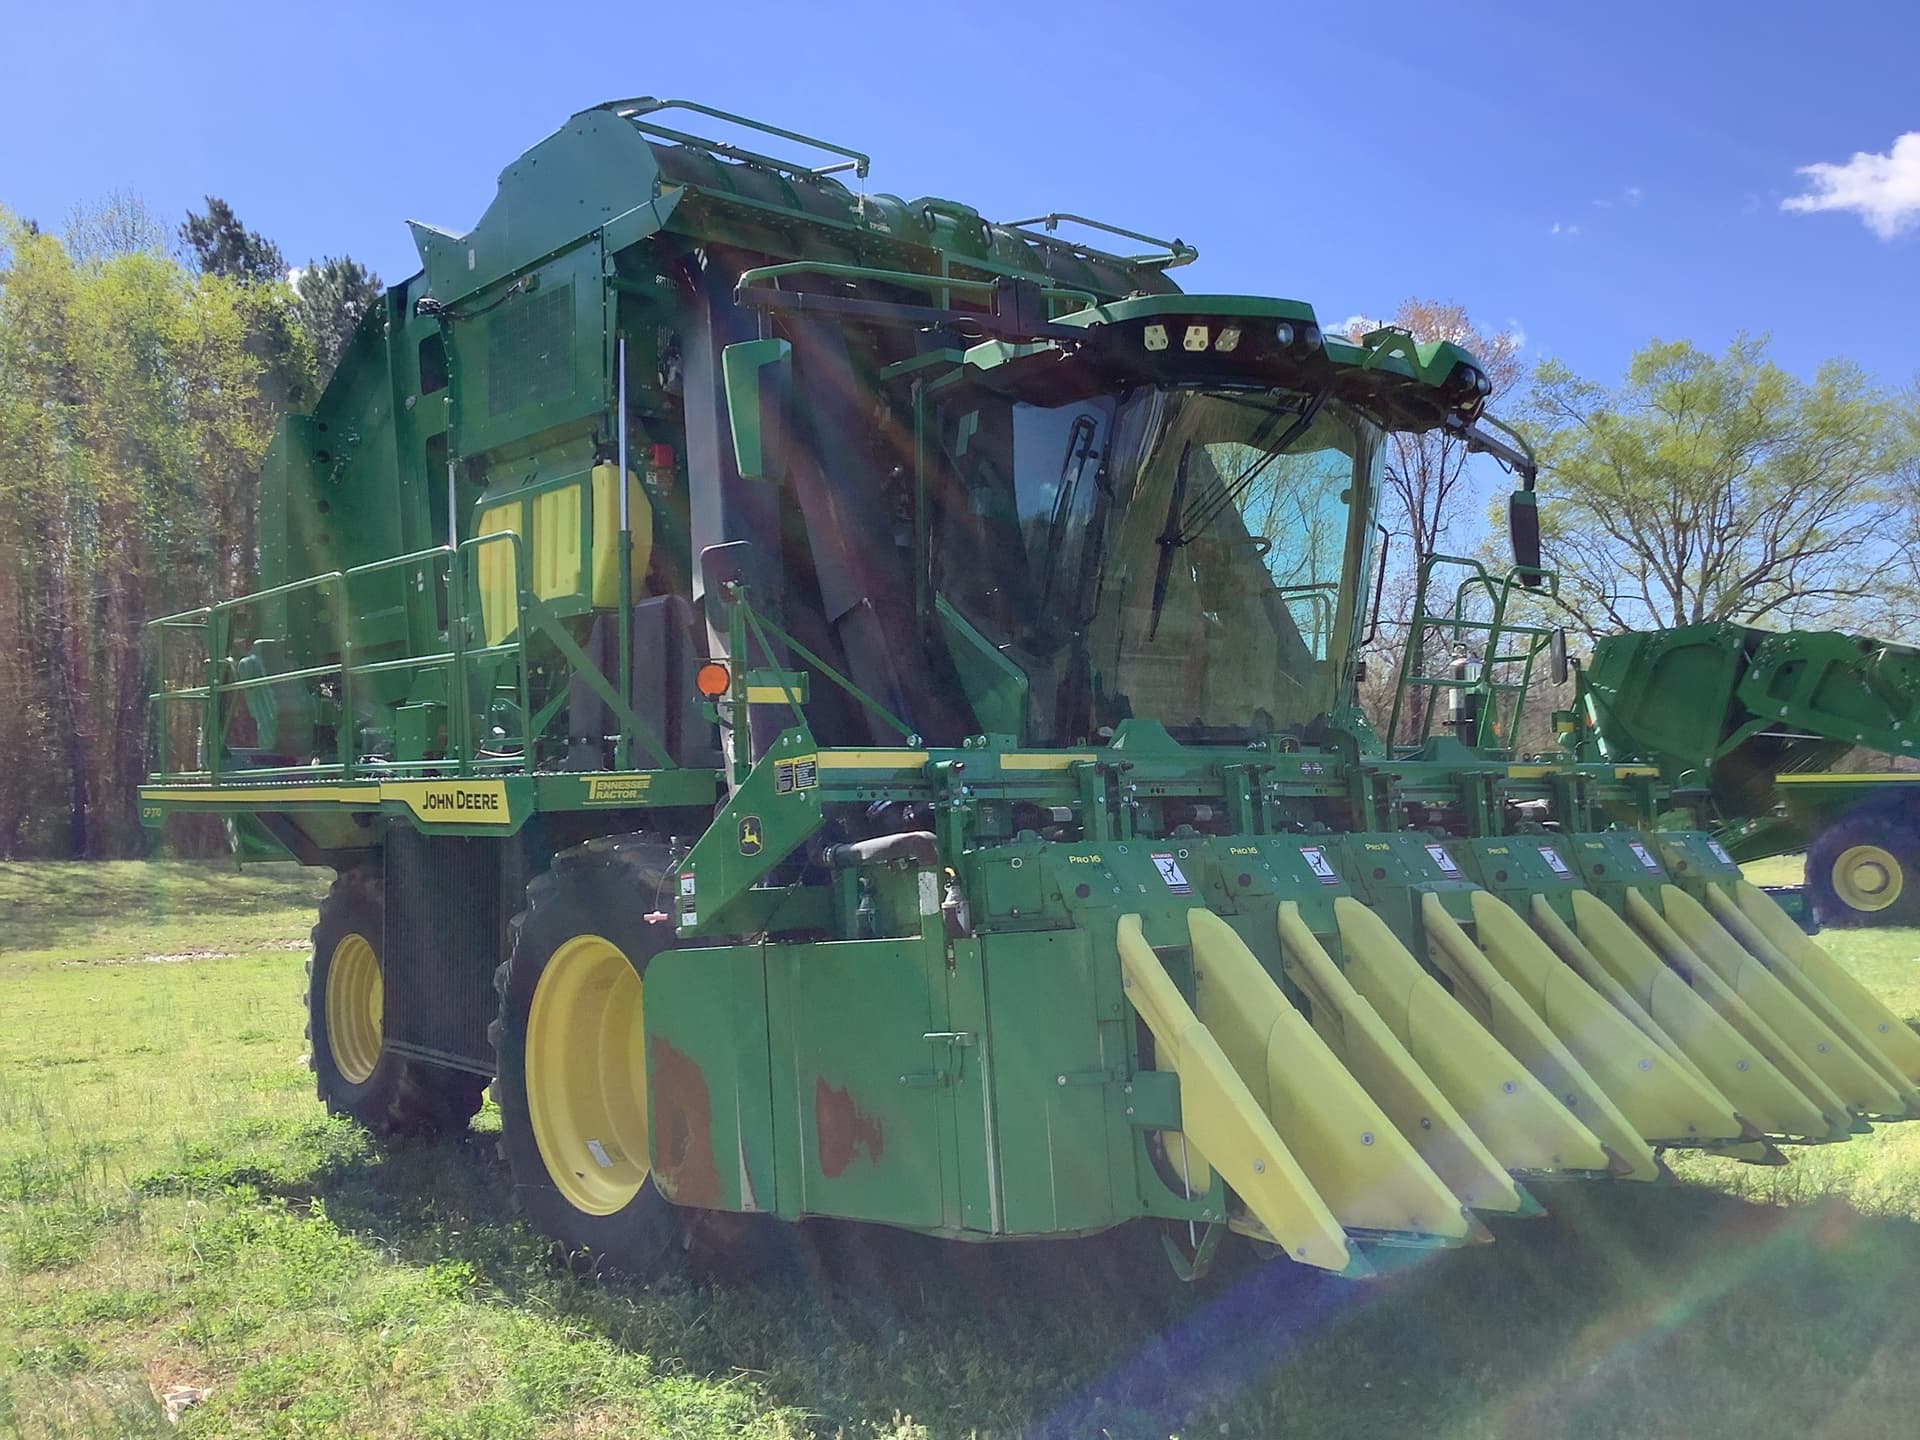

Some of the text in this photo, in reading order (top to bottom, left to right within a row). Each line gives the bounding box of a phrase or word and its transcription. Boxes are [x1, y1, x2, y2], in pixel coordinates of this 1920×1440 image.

[422, 790, 498, 809] JOHN DEERE
[1069, 855, 1089, 864] PRO
